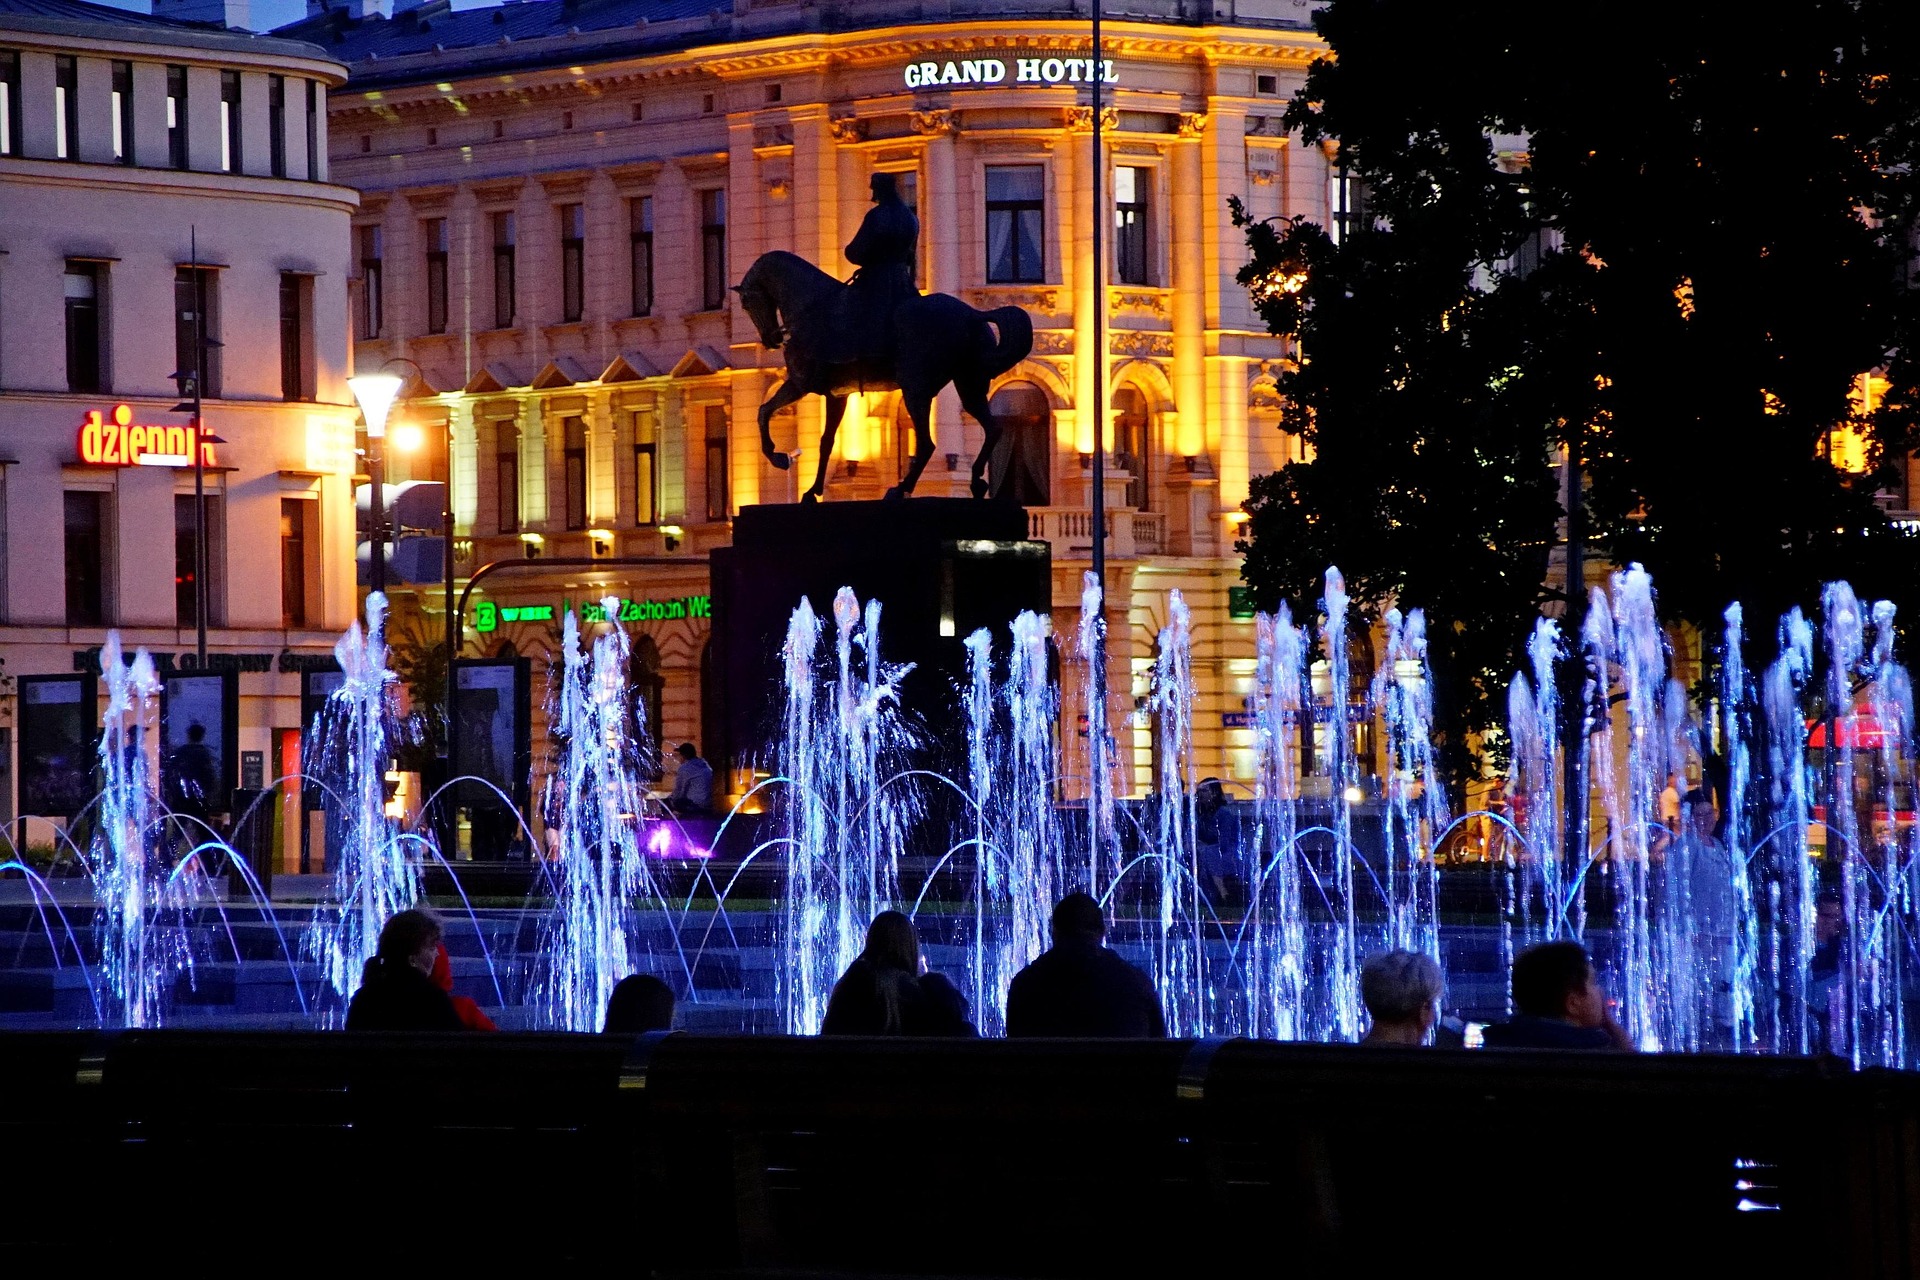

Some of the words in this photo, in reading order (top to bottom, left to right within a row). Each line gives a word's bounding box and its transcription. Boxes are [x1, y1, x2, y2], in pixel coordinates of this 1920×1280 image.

[904, 59, 1006, 87] GRAND
[1016, 58, 1120, 83] HOTEL
[580, 601, 614, 622] Ban
[619, 598, 685, 622] Zachodni
